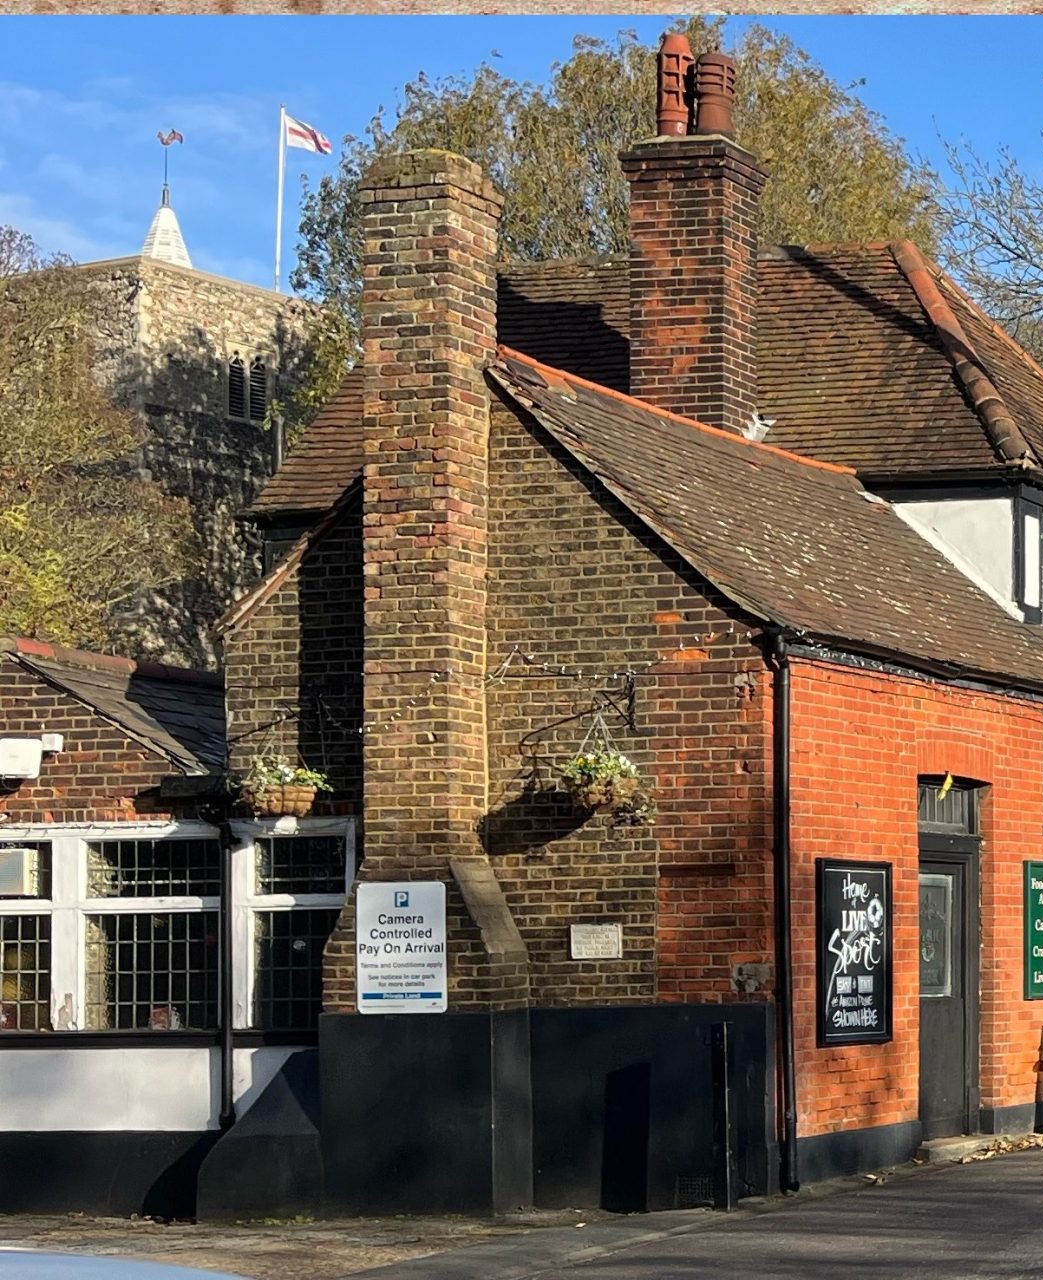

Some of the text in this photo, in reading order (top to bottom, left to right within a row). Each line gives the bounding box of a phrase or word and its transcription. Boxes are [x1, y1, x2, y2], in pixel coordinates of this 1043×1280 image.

[378, 914, 424, 925] Camera
[841, 910, 868, 932] LIVE
[370, 928, 432, 939] Controlled
[359, 942, 444, 956] Pay On Arrival
[828, 928, 883, 974] Sport
[832, 1007, 878, 1027] SHOWN HERE
